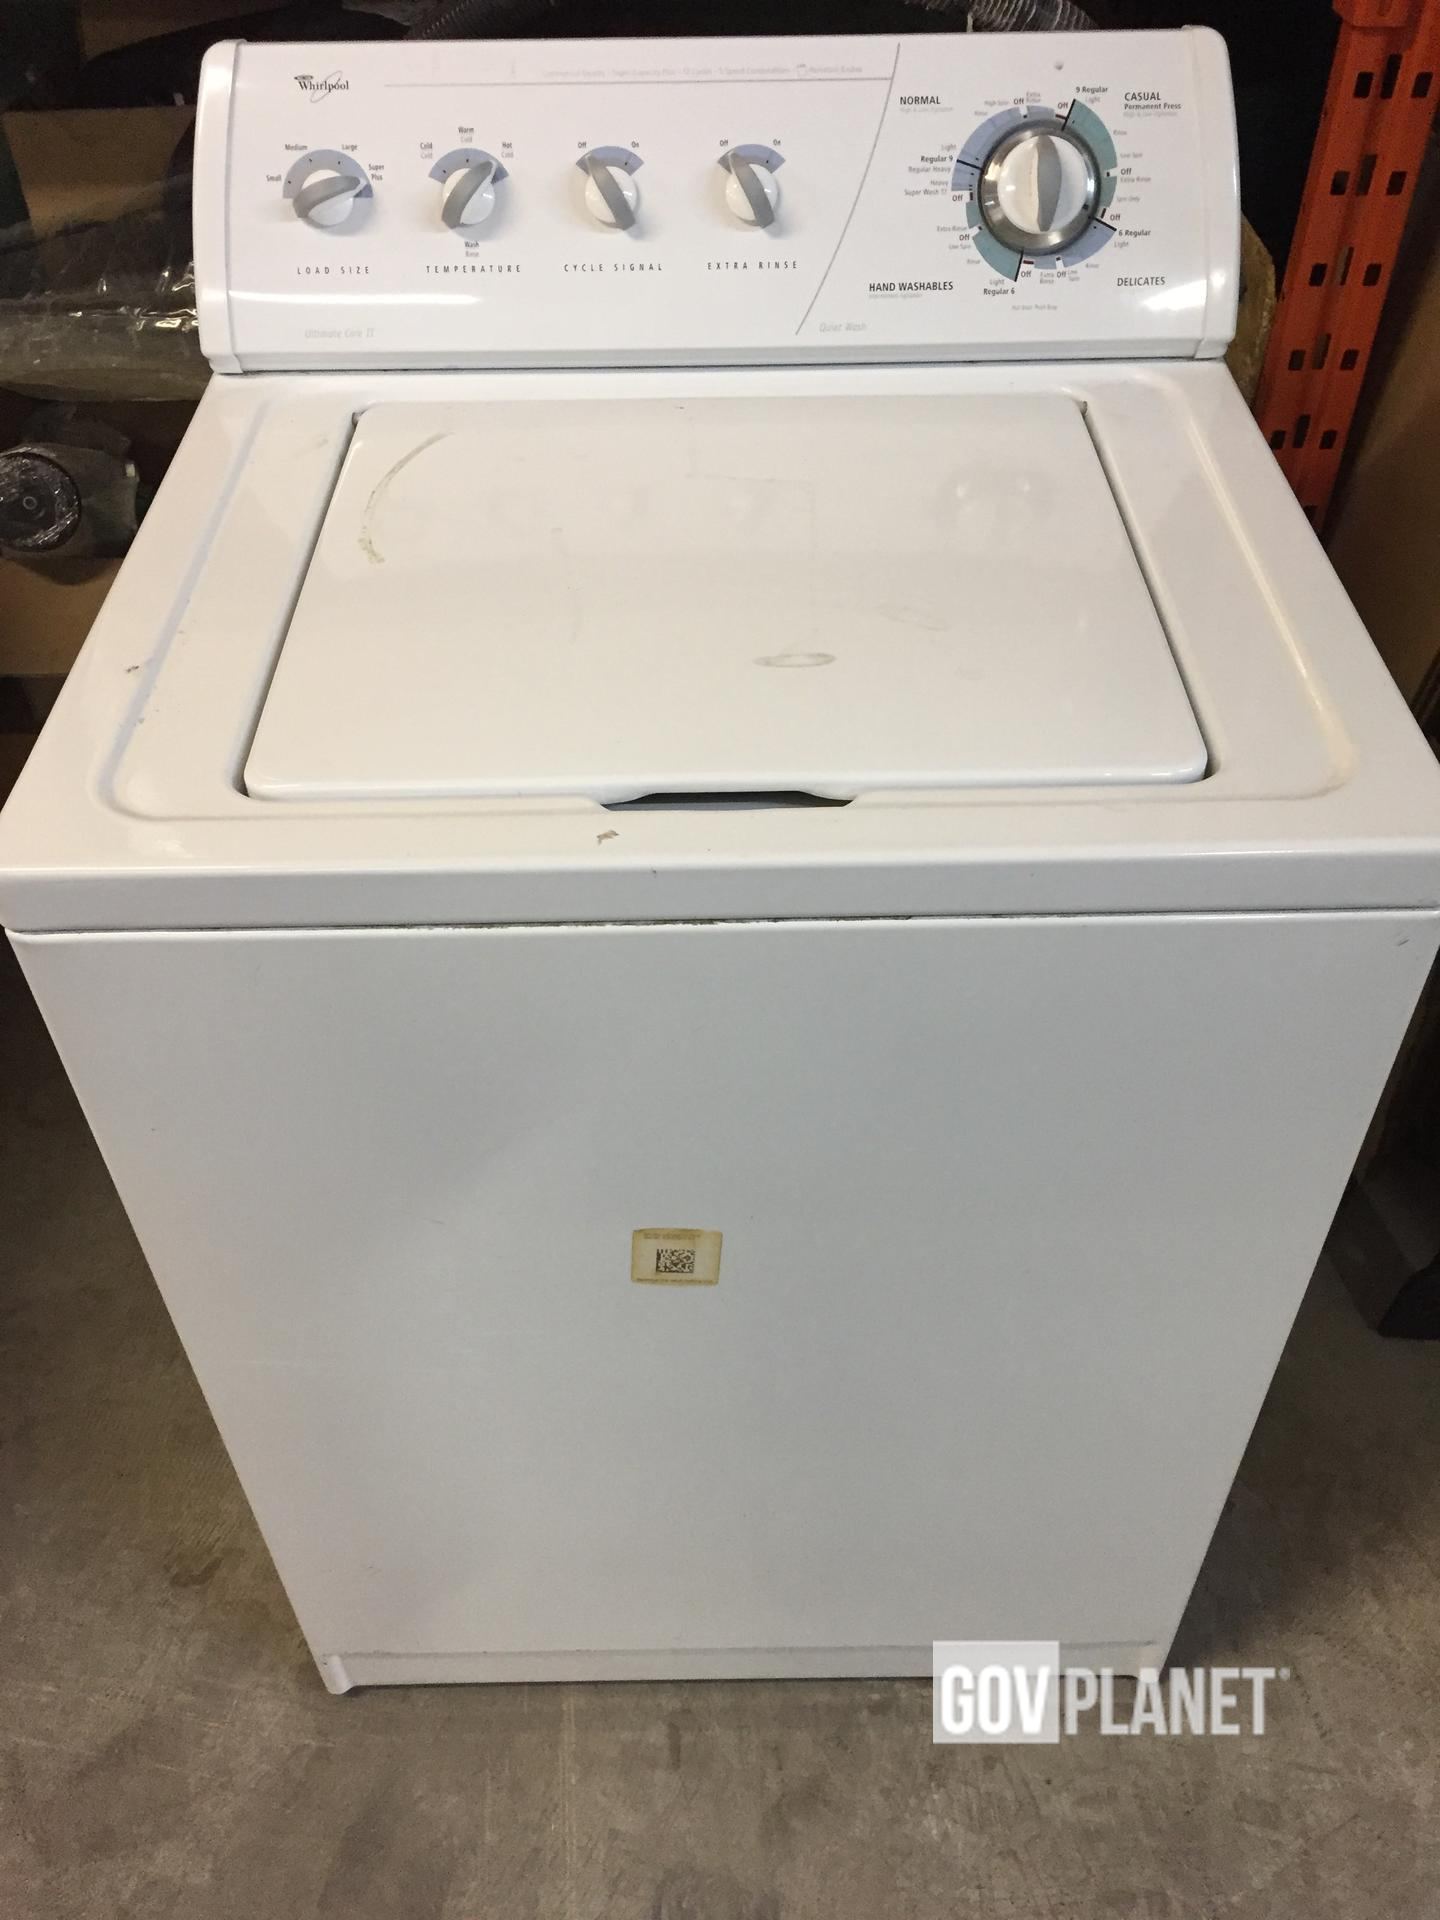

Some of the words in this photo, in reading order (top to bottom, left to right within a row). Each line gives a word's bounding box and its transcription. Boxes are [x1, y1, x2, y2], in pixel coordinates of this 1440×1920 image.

[298, 79, 349, 93] Whirlpool
[1082, 86, 1108, 95] Regular
[900, 96, 941, 105] NORMAL
[1123, 92, 1162, 102] CASUAL
[1057, 102, 1069, 110] Off
[1124, 103, 1162, 111] Permanent
[1163, 102, 1181, 110] Press
[457, 126, 474, 134] Warm
[420, 142, 433, 150] Cold
[502, 141, 512, 149] Hot
[577, 141, 587, 149] Off
[631, 140, 639, 148] On
[719, 139, 729, 147] Off
[772, 138, 781, 146] On
[284, 143, 308, 151] Medium
[341, 143, 358, 152] Large
[921, 155, 947, 164] Regular
[368, 164, 385, 172] Super
[1120, 168, 1132, 176] Off
[266, 174, 282, 182] Small
[952, 194, 963, 202] Off
[1110, 213, 1121, 221] Off
[1124, 229, 1151, 237] Regular
[464, 240, 480, 248] Wash
[426, 264, 521, 274] TEMPERATURE
[563, 263, 604, 272] CYCLE
[613, 263, 663, 271] SIGNAL
[707, 262, 748, 270] EXTRA
[758, 261, 797, 269] RINSE
[297, 266, 331, 275] LOAD
[340, 266, 371, 274] SIZE
[1021, 270, 1032, 278] Off
[1056, 270, 1067, 278] Off
[1116, 276, 1166, 287] DELICATES
[869, 283, 896, 292] HAND
[898, 281, 954, 291] WASHABLES
[983, 288, 1009, 297] Regular
